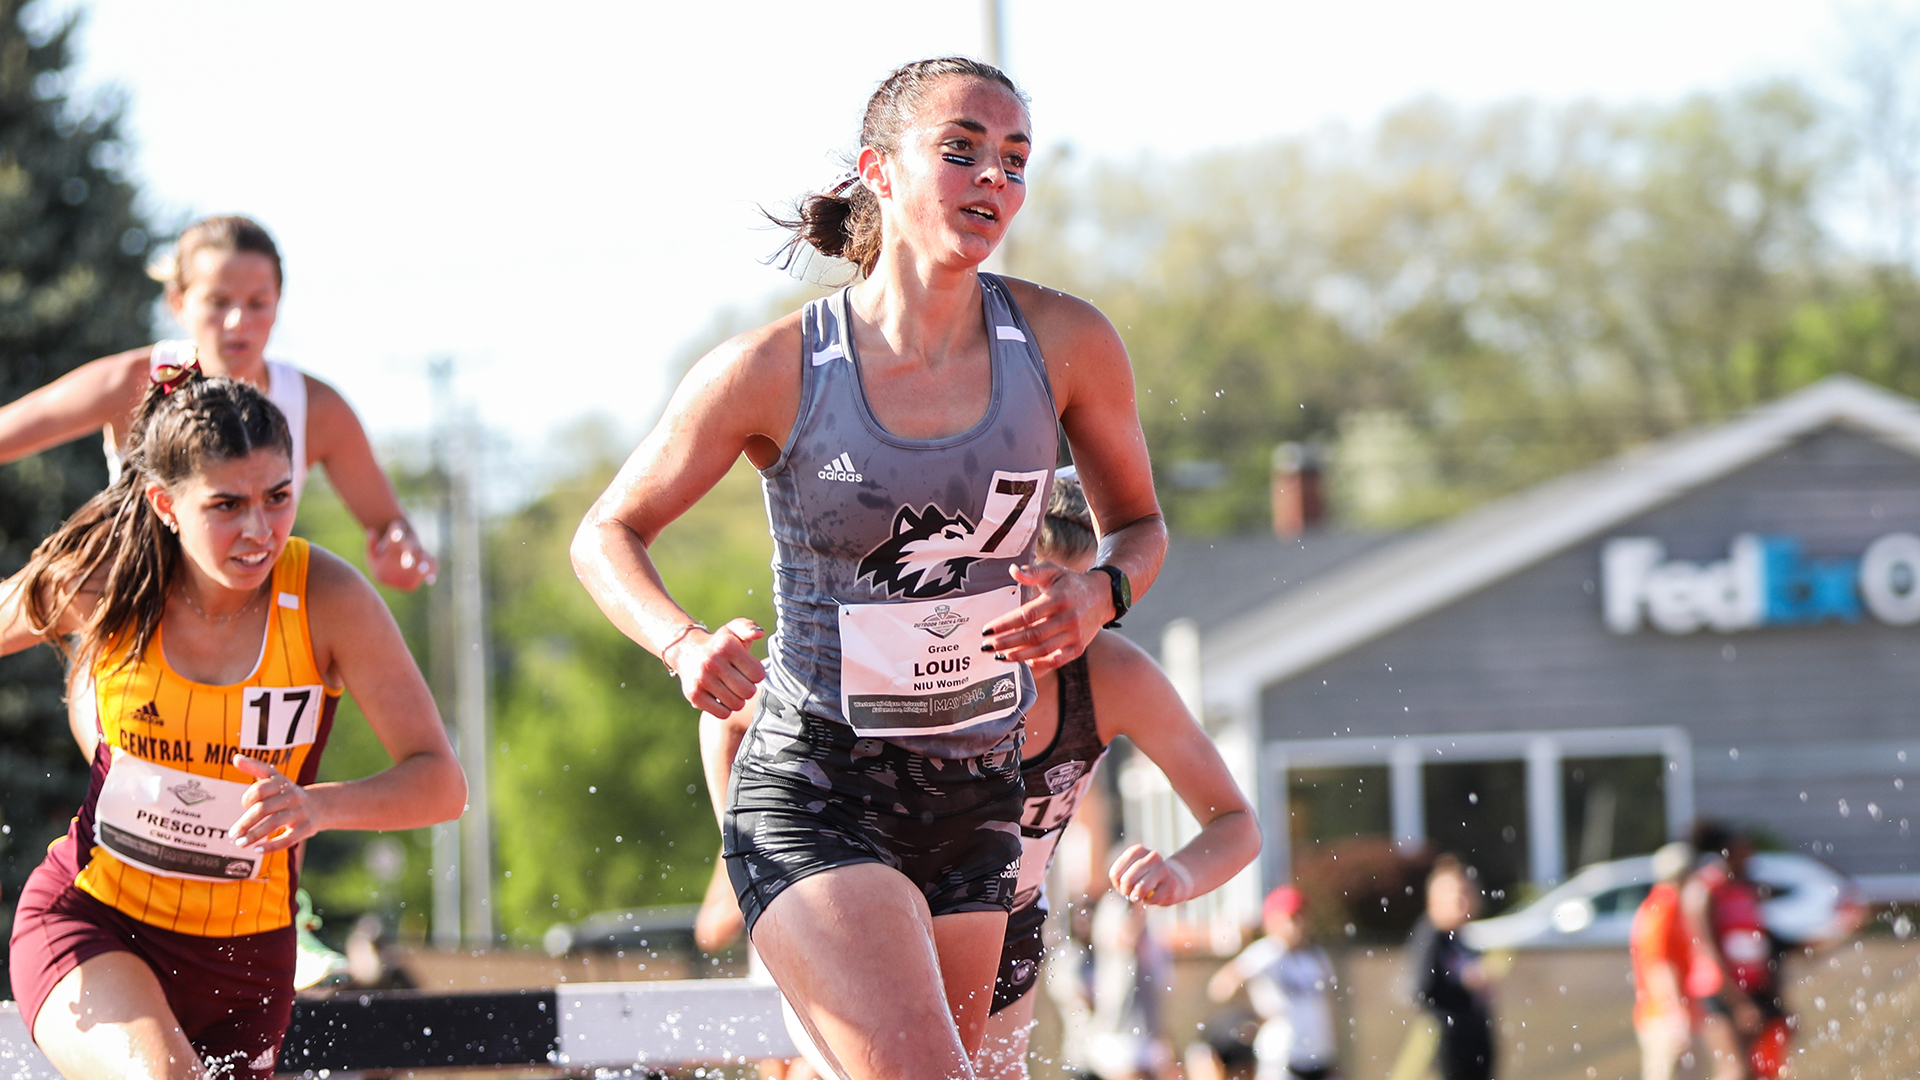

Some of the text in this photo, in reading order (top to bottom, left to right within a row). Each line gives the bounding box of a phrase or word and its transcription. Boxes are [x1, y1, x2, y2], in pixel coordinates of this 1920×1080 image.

[817, 469, 863, 482] adidas
[979, 479, 1038, 553] 7
[1603, 534, 1862, 634] FedEx
[928, 643, 959, 654] Grace
[914, 656, 971, 677] LOUIS
[913, 676, 970, 691] NIU Women
[250, 689, 311, 746] 17
[934, 699, 960, 712] MAY
[120, 729, 193, 762] CENTRAL
[1029, 785, 1079, 826] 13
[136, 809, 229, 839] PRESCOTT
[173, 836, 207, 848] Women
